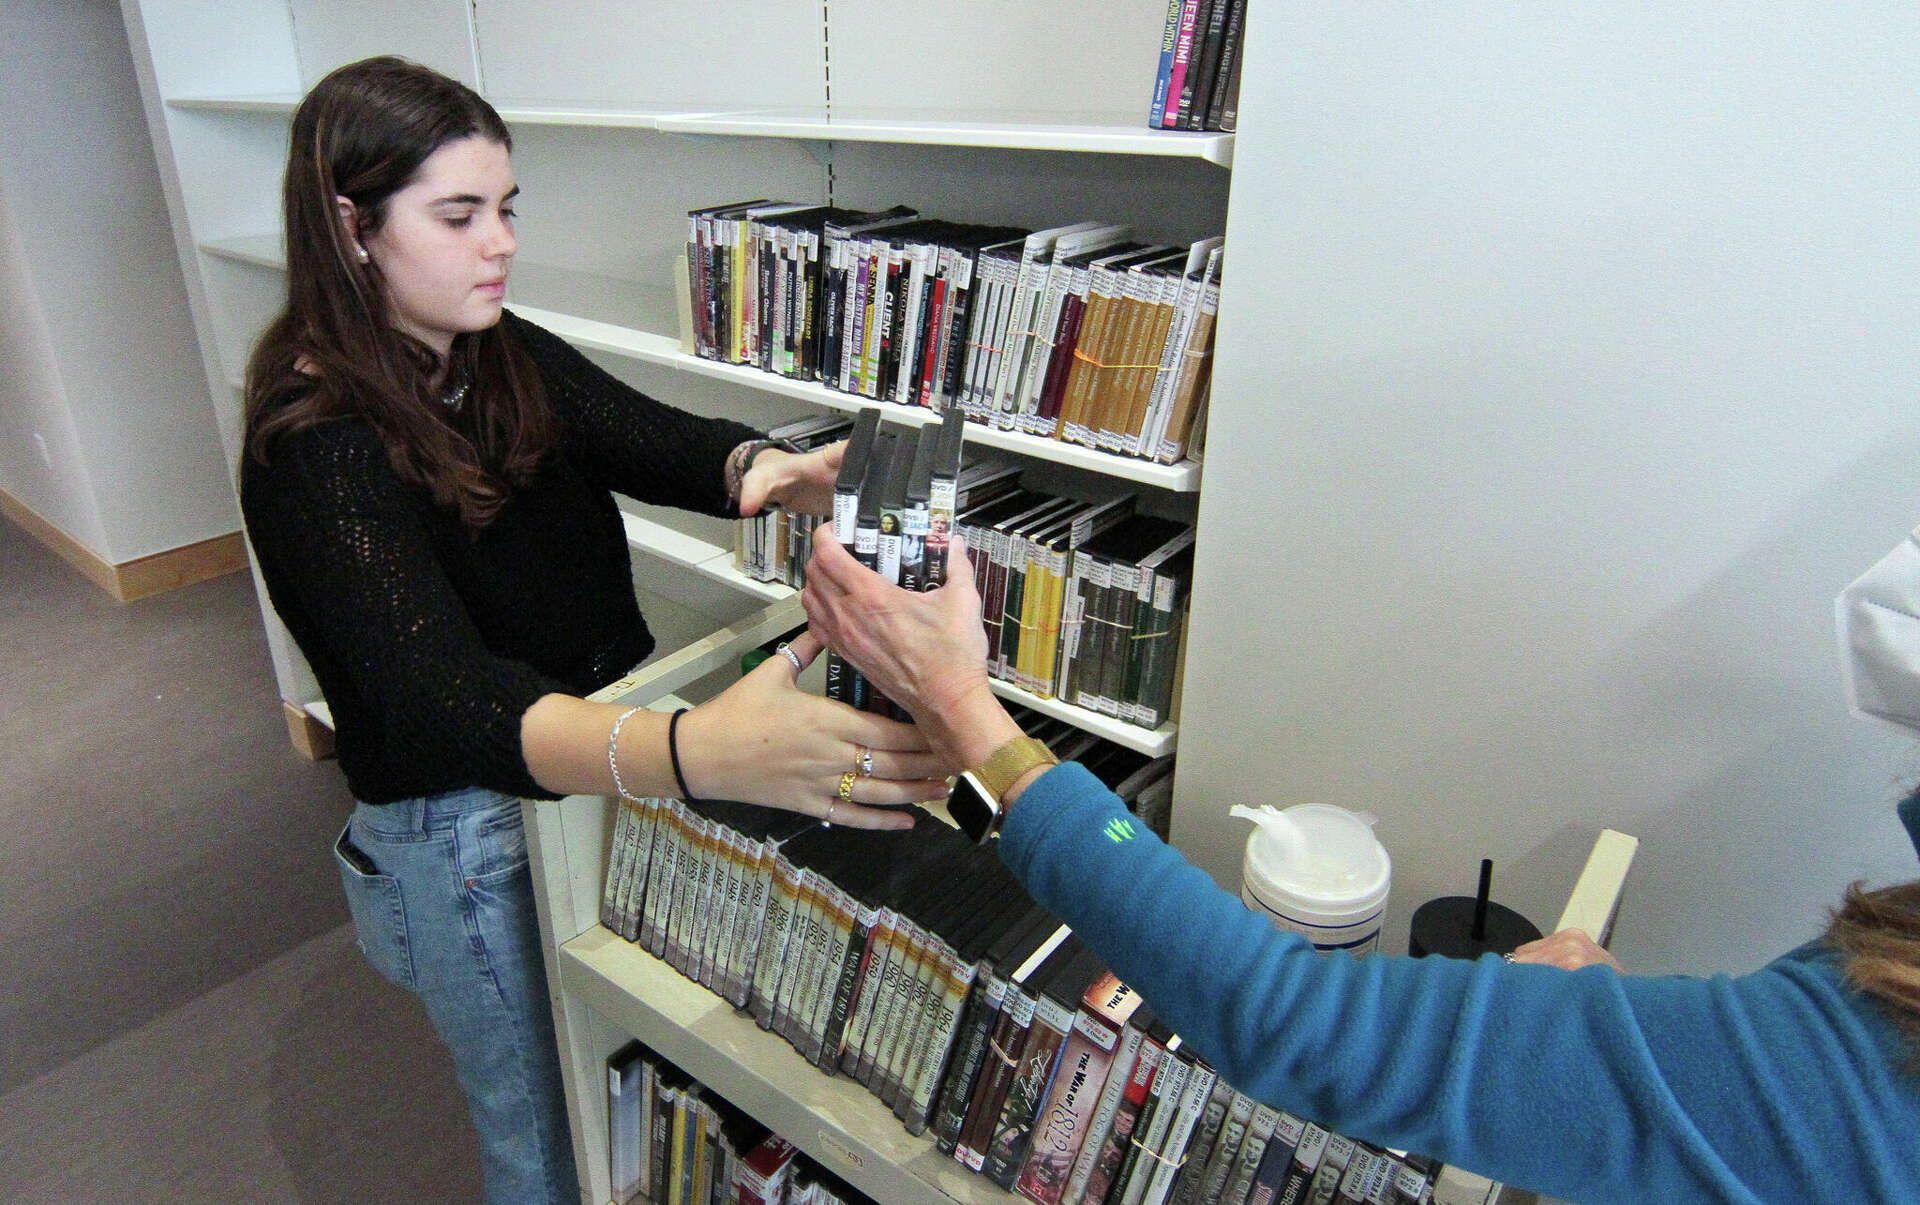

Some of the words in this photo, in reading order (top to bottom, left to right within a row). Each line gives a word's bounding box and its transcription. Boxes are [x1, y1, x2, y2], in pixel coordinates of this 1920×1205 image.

[1166, 0, 1180, 23] ORLD
[1163, 23, 1175, 53] WITHIN
[1175, 35, 1192, 63] MIMI
[1220, 39, 1232, 74] LANGE
[806, 276, 814, 298] LINDA
[866, 270, 876, 306] SENNA
[899, 278, 908, 322] NIKOLA
[785, 300, 793, 336] WITNESSES
[855, 299, 863, 326] SISTER
[882, 291, 893, 339] CLIENT
[853, 327, 862, 354] MARIA
[833, 498, 841, 538] LEONARDO
[930, 560, 939, 579] THE
[829, 664, 841, 681] DA
[728, 878, 739, 902] 1948
[767, 898, 779, 922] 1965
[776, 906, 790, 933] 1966
[807, 920, 820, 946] 1952
[830, 939, 845, 966] 1954
[867, 951, 881, 978] 1959
[884, 960, 899, 989] 1960
[898, 970, 913, 1000] 1961
[911, 978, 927, 1007] 1962
[924, 992, 941, 1019] 1963
[1107, 992, 1123, 1010] THE
[936, 1007, 953, 1035] 1964
[1078, 1052, 1090, 1070] THE
[1070, 1071, 1086, 1091] WAR
[1067, 1092, 1075, 1106] OF
[1237, 1095, 1254, 1107] DVD
[1042, 1098, 1079, 1152] 1812
[1357, 1153, 1370, 1170] DVD
